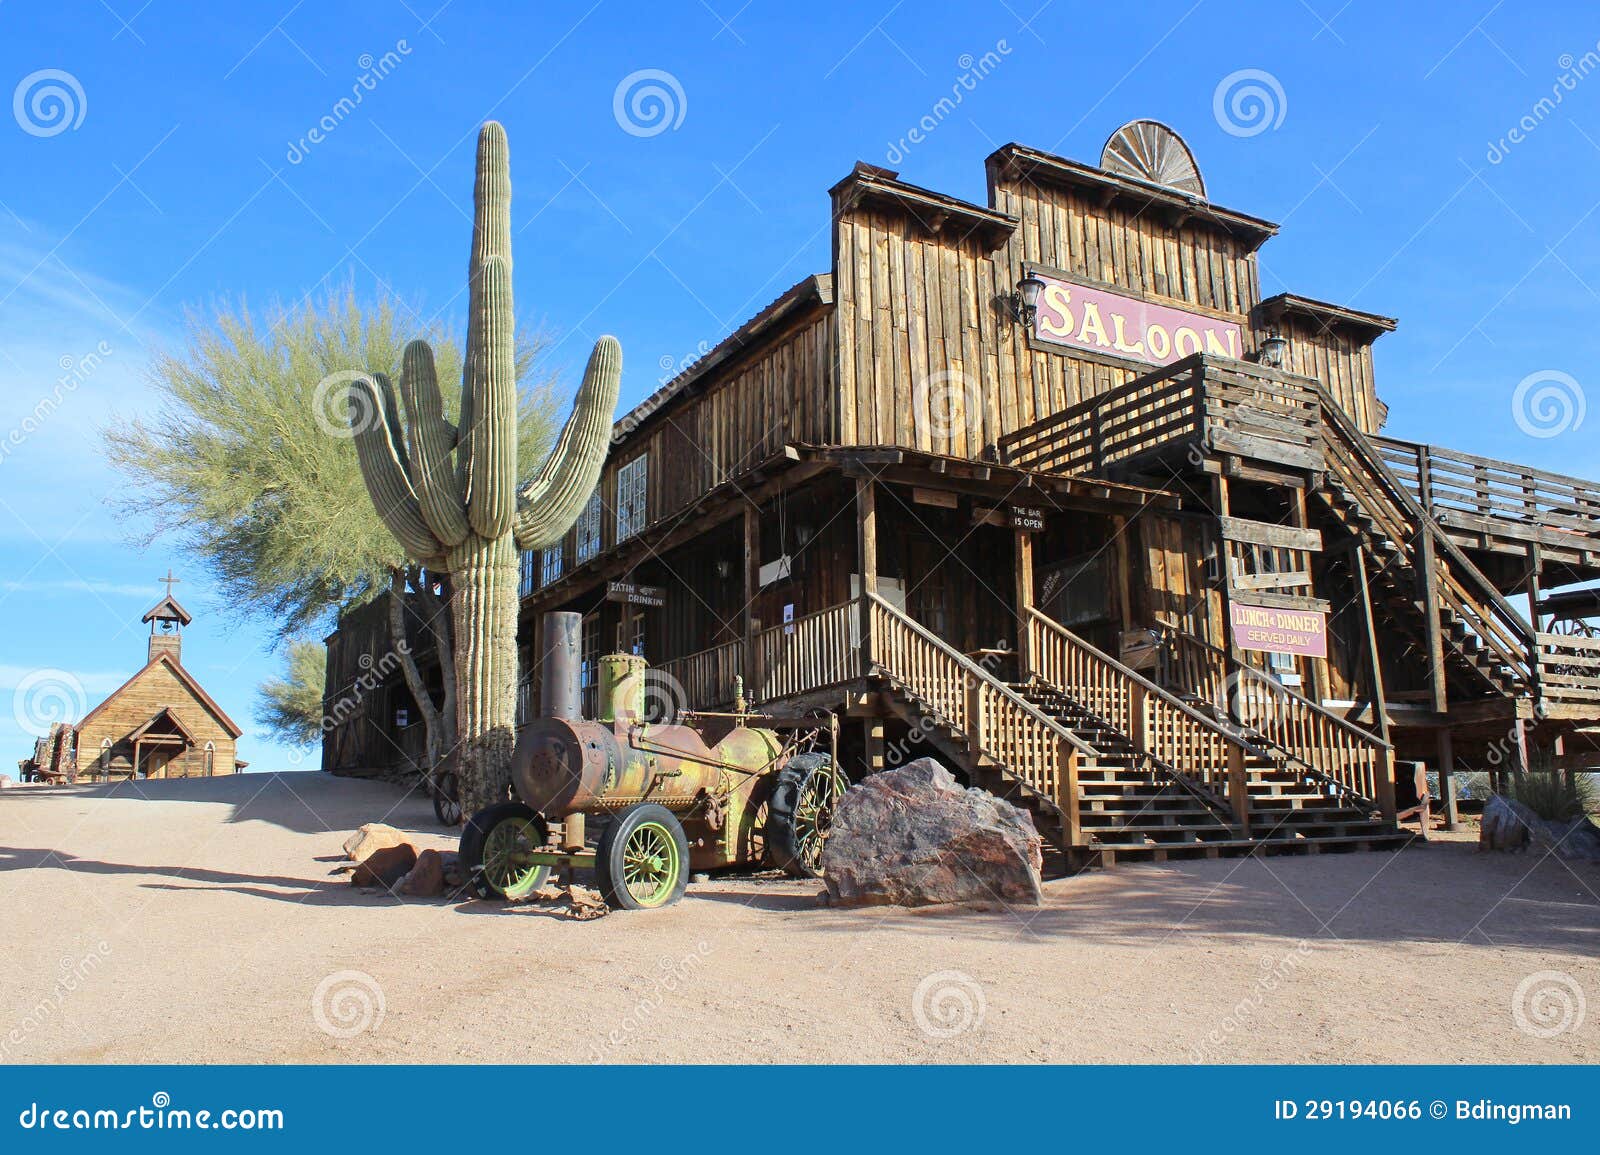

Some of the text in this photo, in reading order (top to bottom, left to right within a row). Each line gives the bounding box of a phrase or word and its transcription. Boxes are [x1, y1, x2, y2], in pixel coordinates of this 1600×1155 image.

[1040, 284, 1237, 360] SALOON
[1012, 506, 1041, 517] THE BAR
[1014, 517, 1043, 529] IS OPEN
[1235, 608, 1270, 628] LUNCH
[1276, 613, 1321, 634] DINNER
[1247, 630, 1311, 646] SERVED DAILY
